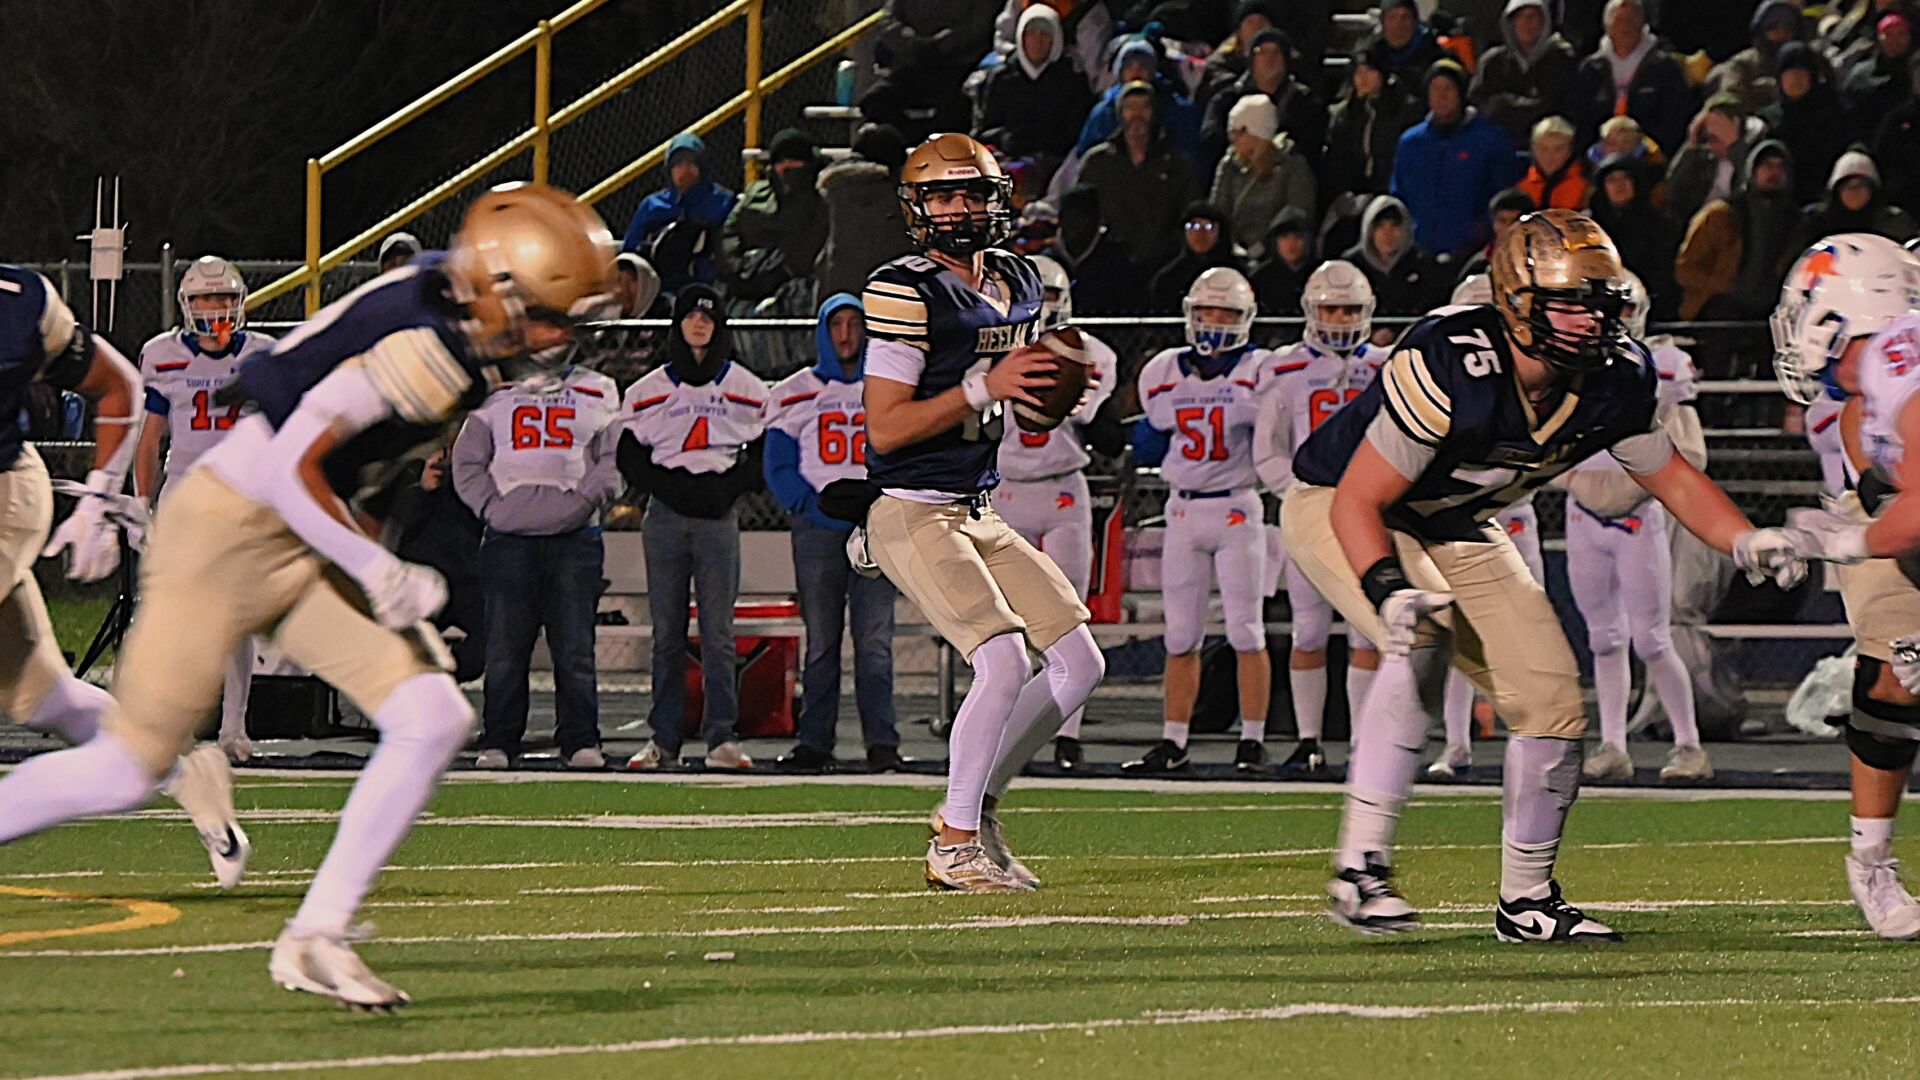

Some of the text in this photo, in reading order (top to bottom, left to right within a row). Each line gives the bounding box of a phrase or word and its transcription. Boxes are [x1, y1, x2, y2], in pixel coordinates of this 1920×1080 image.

[1447, 328, 1503, 378] 75
[511, 404, 576, 450] 65
[1175, 406, 1230, 461] 51
[1309, 388, 1362, 433] 6
[681, 415, 710, 453] 4
